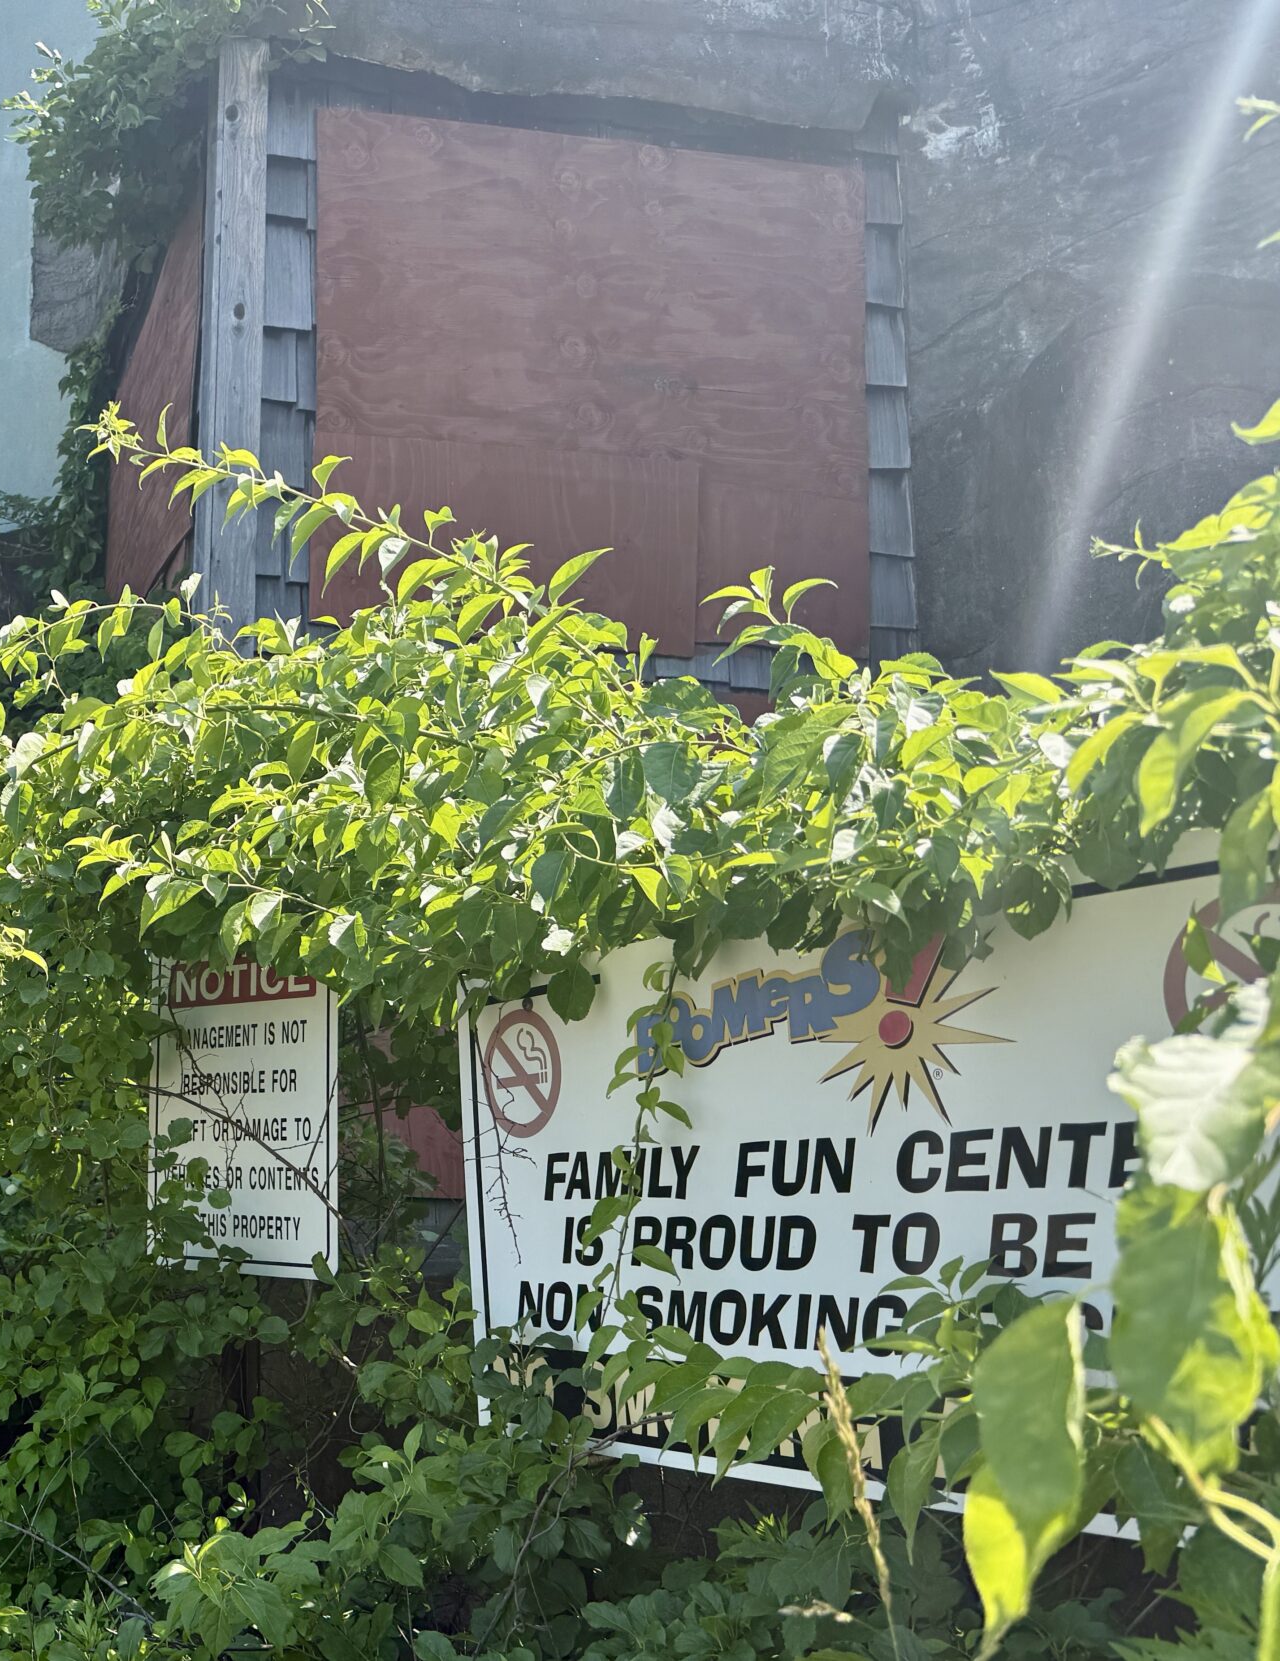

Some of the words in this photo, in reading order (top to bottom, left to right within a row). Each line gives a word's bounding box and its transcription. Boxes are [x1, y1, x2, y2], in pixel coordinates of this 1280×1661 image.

[263, 1021, 276, 1046] IS
[281, 1019, 308, 1045] NOT
[182, 1070, 266, 1096] RESPONSIBLE
[271, 1068, 297, 1093] FOR
[212, 1119, 229, 1142] OR
[235, 1117, 288, 1142] DAMAGE
[294, 1117, 312, 1142] TO
[226, 1166, 243, 1191] OR
[249, 1166, 320, 1192] CONTENTS
[543, 1145, 701, 1202] FAMILY
[733, 1137, 857, 1199] FUN
[232, 1214, 301, 1241] PROPERTY
[562, 1215, 605, 1267] IS
[630, 1214, 818, 1272] PROUD
[852, 1211, 941, 1275] TO
[986, 1212, 1097, 1280] BE
[518, 1280, 909, 1358] NONSMOKING
